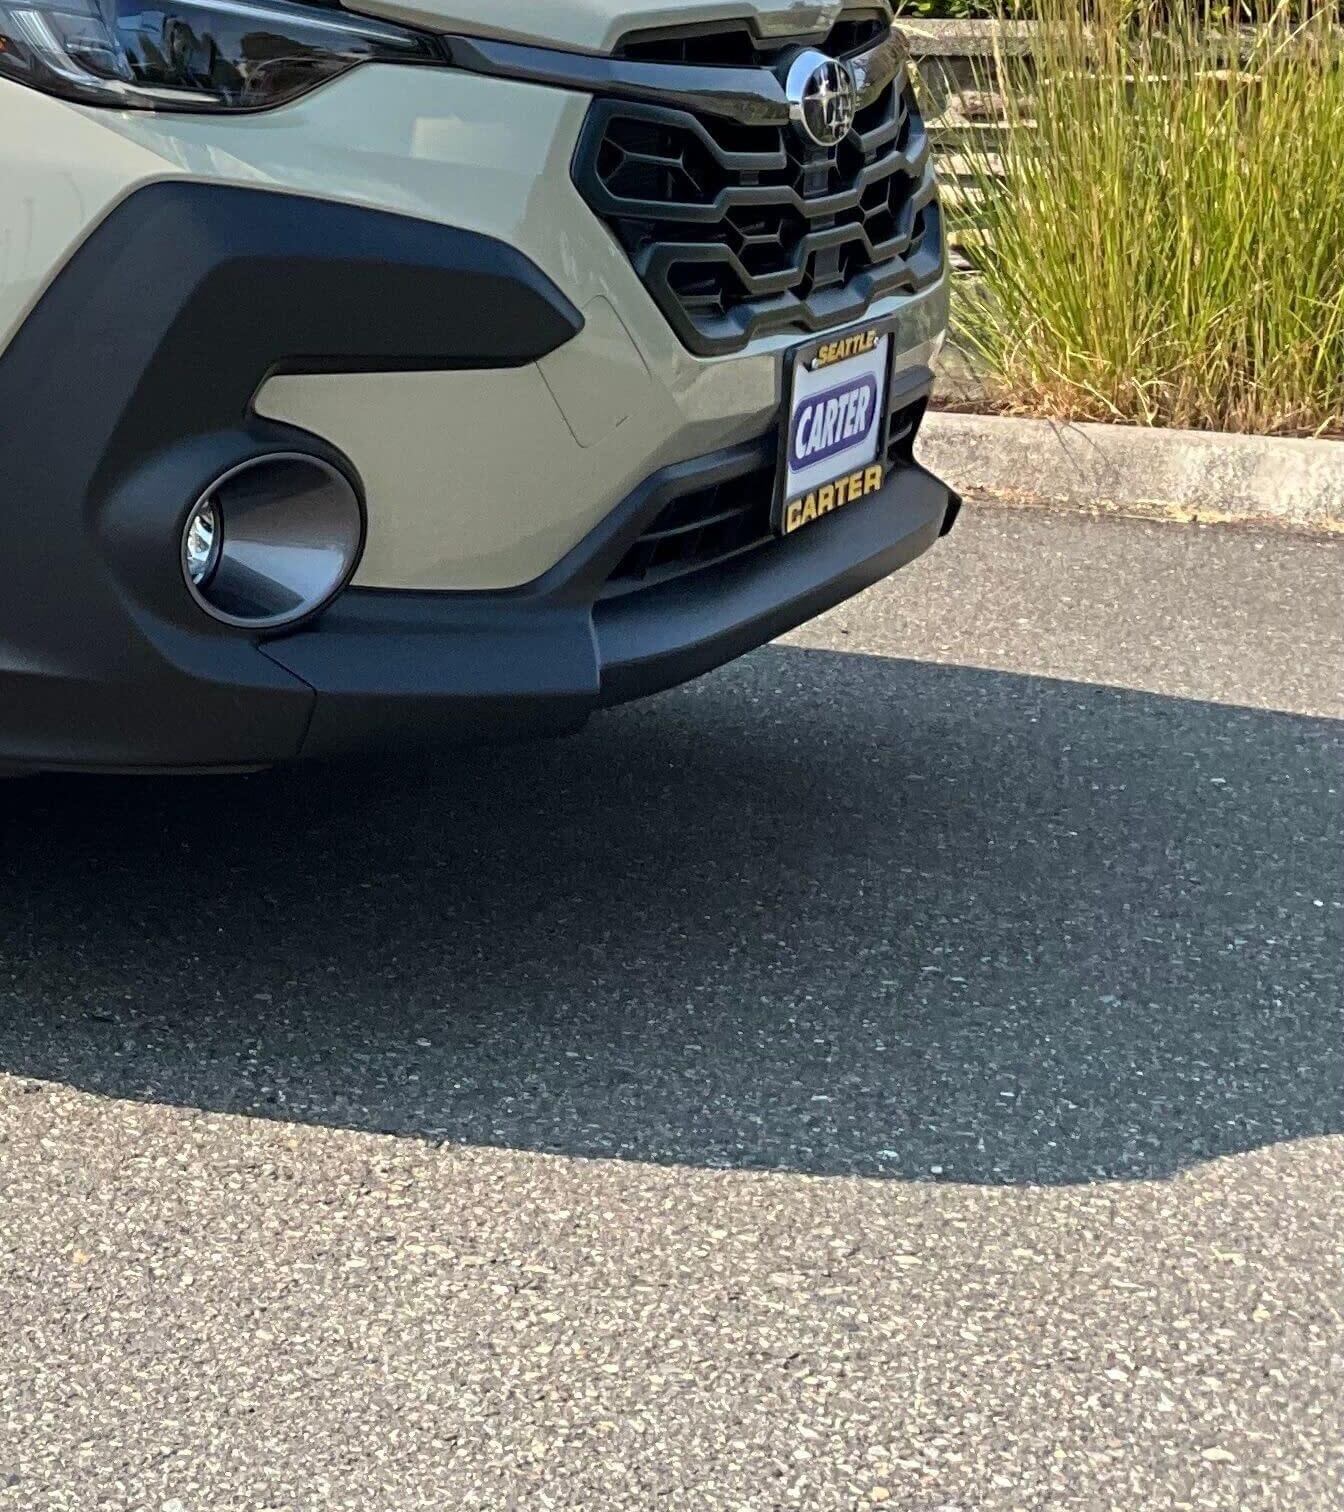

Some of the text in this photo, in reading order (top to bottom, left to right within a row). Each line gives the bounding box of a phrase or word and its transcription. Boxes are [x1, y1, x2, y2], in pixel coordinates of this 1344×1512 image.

[818, 330, 876, 367] SEATTLE
[795, 385, 871, 459] CARTER
[786, 465, 882, 533] CARTER
